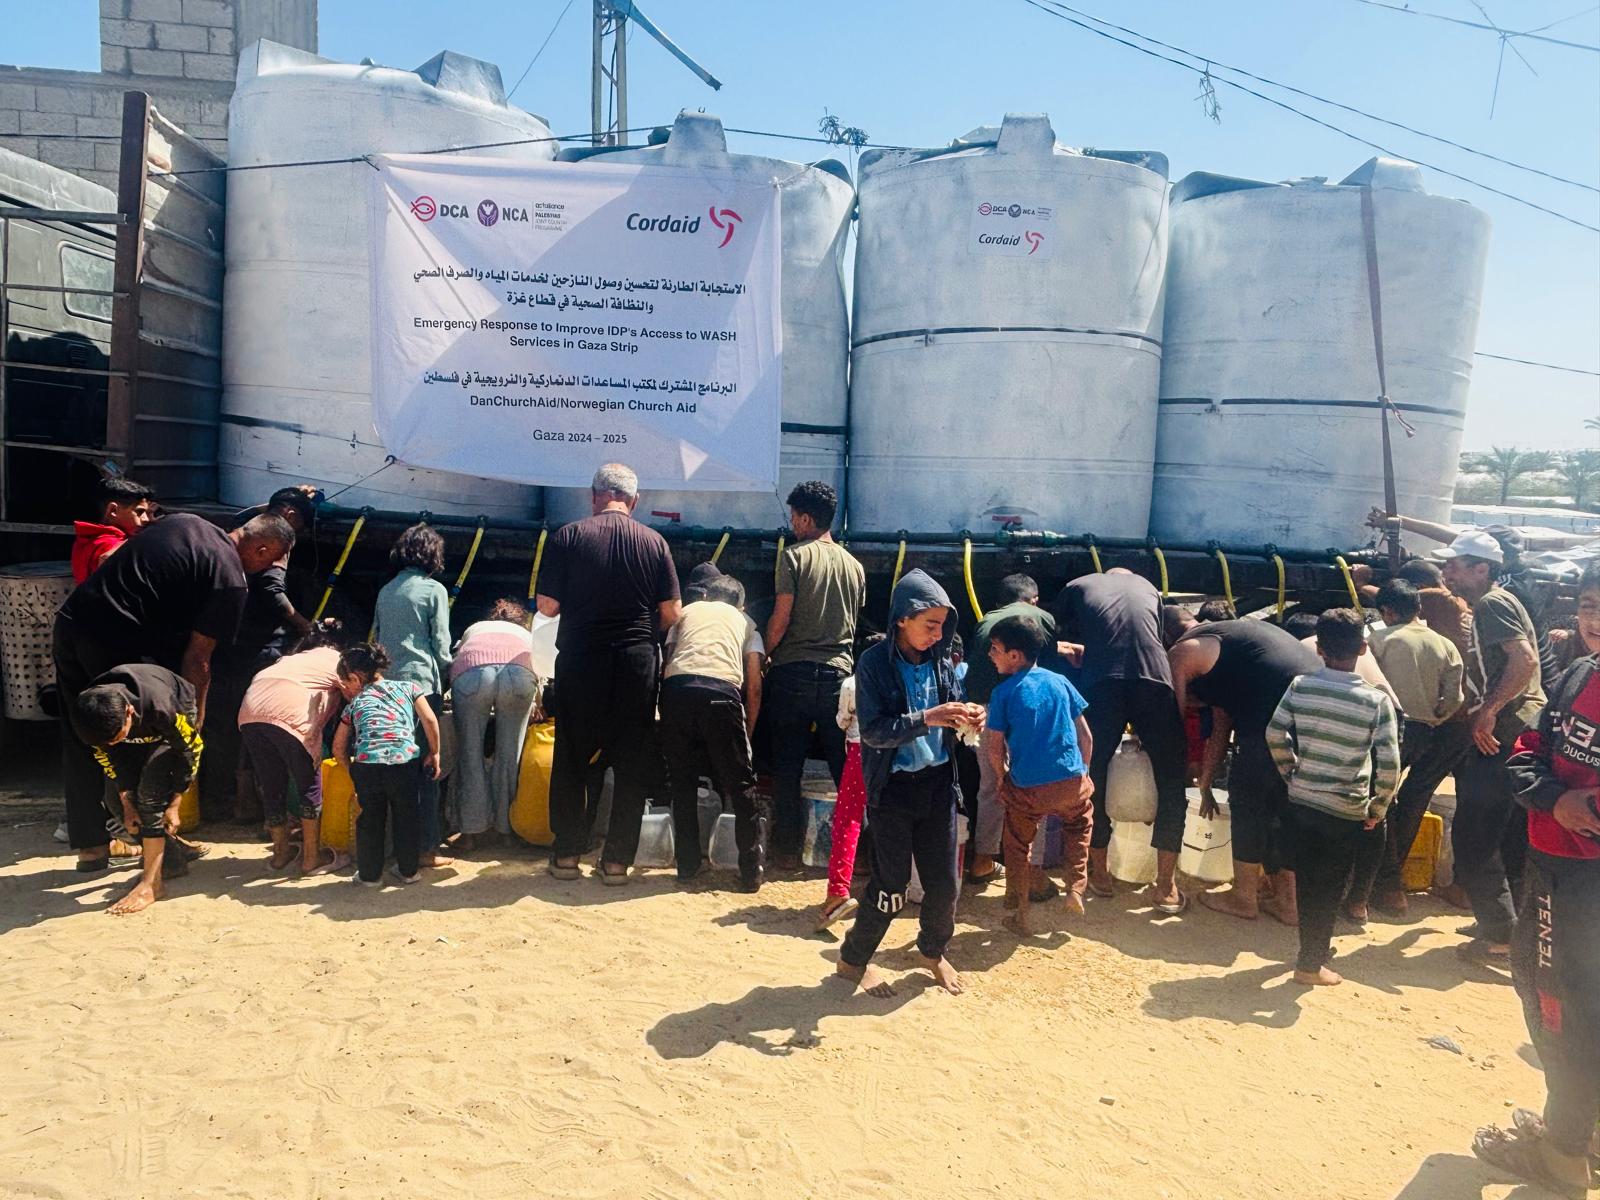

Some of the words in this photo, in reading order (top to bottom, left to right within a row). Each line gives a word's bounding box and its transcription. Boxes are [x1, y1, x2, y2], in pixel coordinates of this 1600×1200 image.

[440, 204, 470, 219] DCA
[502, 207, 529, 222] NCA
[626, 212, 701, 234] Cordaid
[978, 233, 1021, 246] Cordaid
[413, 267, 444, 282] الصحي
[445, 265, 483, 281] والصرف
[485, 269, 509, 283] المياه
[511, 270, 549, 284] لخدمات
[551, 274, 593, 289] النازحين
[594, 276, 623, 290] وصول
[624, 278, 660, 292] لتحسين
[700, 280, 746, 296] الاستجابة
[507, 291, 526, 305] غزة
[528, 293, 556, 307] قطاع
[557, 295, 570, 311] في
[572, 295, 608, 310] الصحية
[610, 296, 654, 314] والنظافة
[414, 318, 477, 331] Emergency
[480, 319, 538, 332] Response
[541, 322, 553, 332] to
[556, 323, 604, 336] Improve
[607, 326, 637, 337] IDP's
[640, 327, 683, 340] Access
[686, 330, 697, 340] to
[700, 330, 737, 341] WASH
[509, 336, 561, 348] Services
[563, 338, 575, 349] in
[577, 339, 608, 351] Gaza
[610, 341, 639, 355] Strip
[423, 370, 460, 384] فلسطين
[461, 371, 472, 388] في
[473, 372, 527, 388] والنرويجية
[527, 373, 580, 388] الدنماركية
[581, 375, 631, 388] المساعدات
[632, 378, 657, 392] لمكتب
[658, 379, 696, 393] المشترك
[697, 381, 737, 396] البرنامج
[470, 395, 625, 412] DanChurchAid/Norwegian
[628, 400, 673, 413] Church
[676, 402, 697, 414] Aid
[533, 429, 565, 442] Gaza
[568, 432, 592, 443] 2024
[603, 433, 628, 443] 2025
[1538, 894, 1552, 968] TENET
